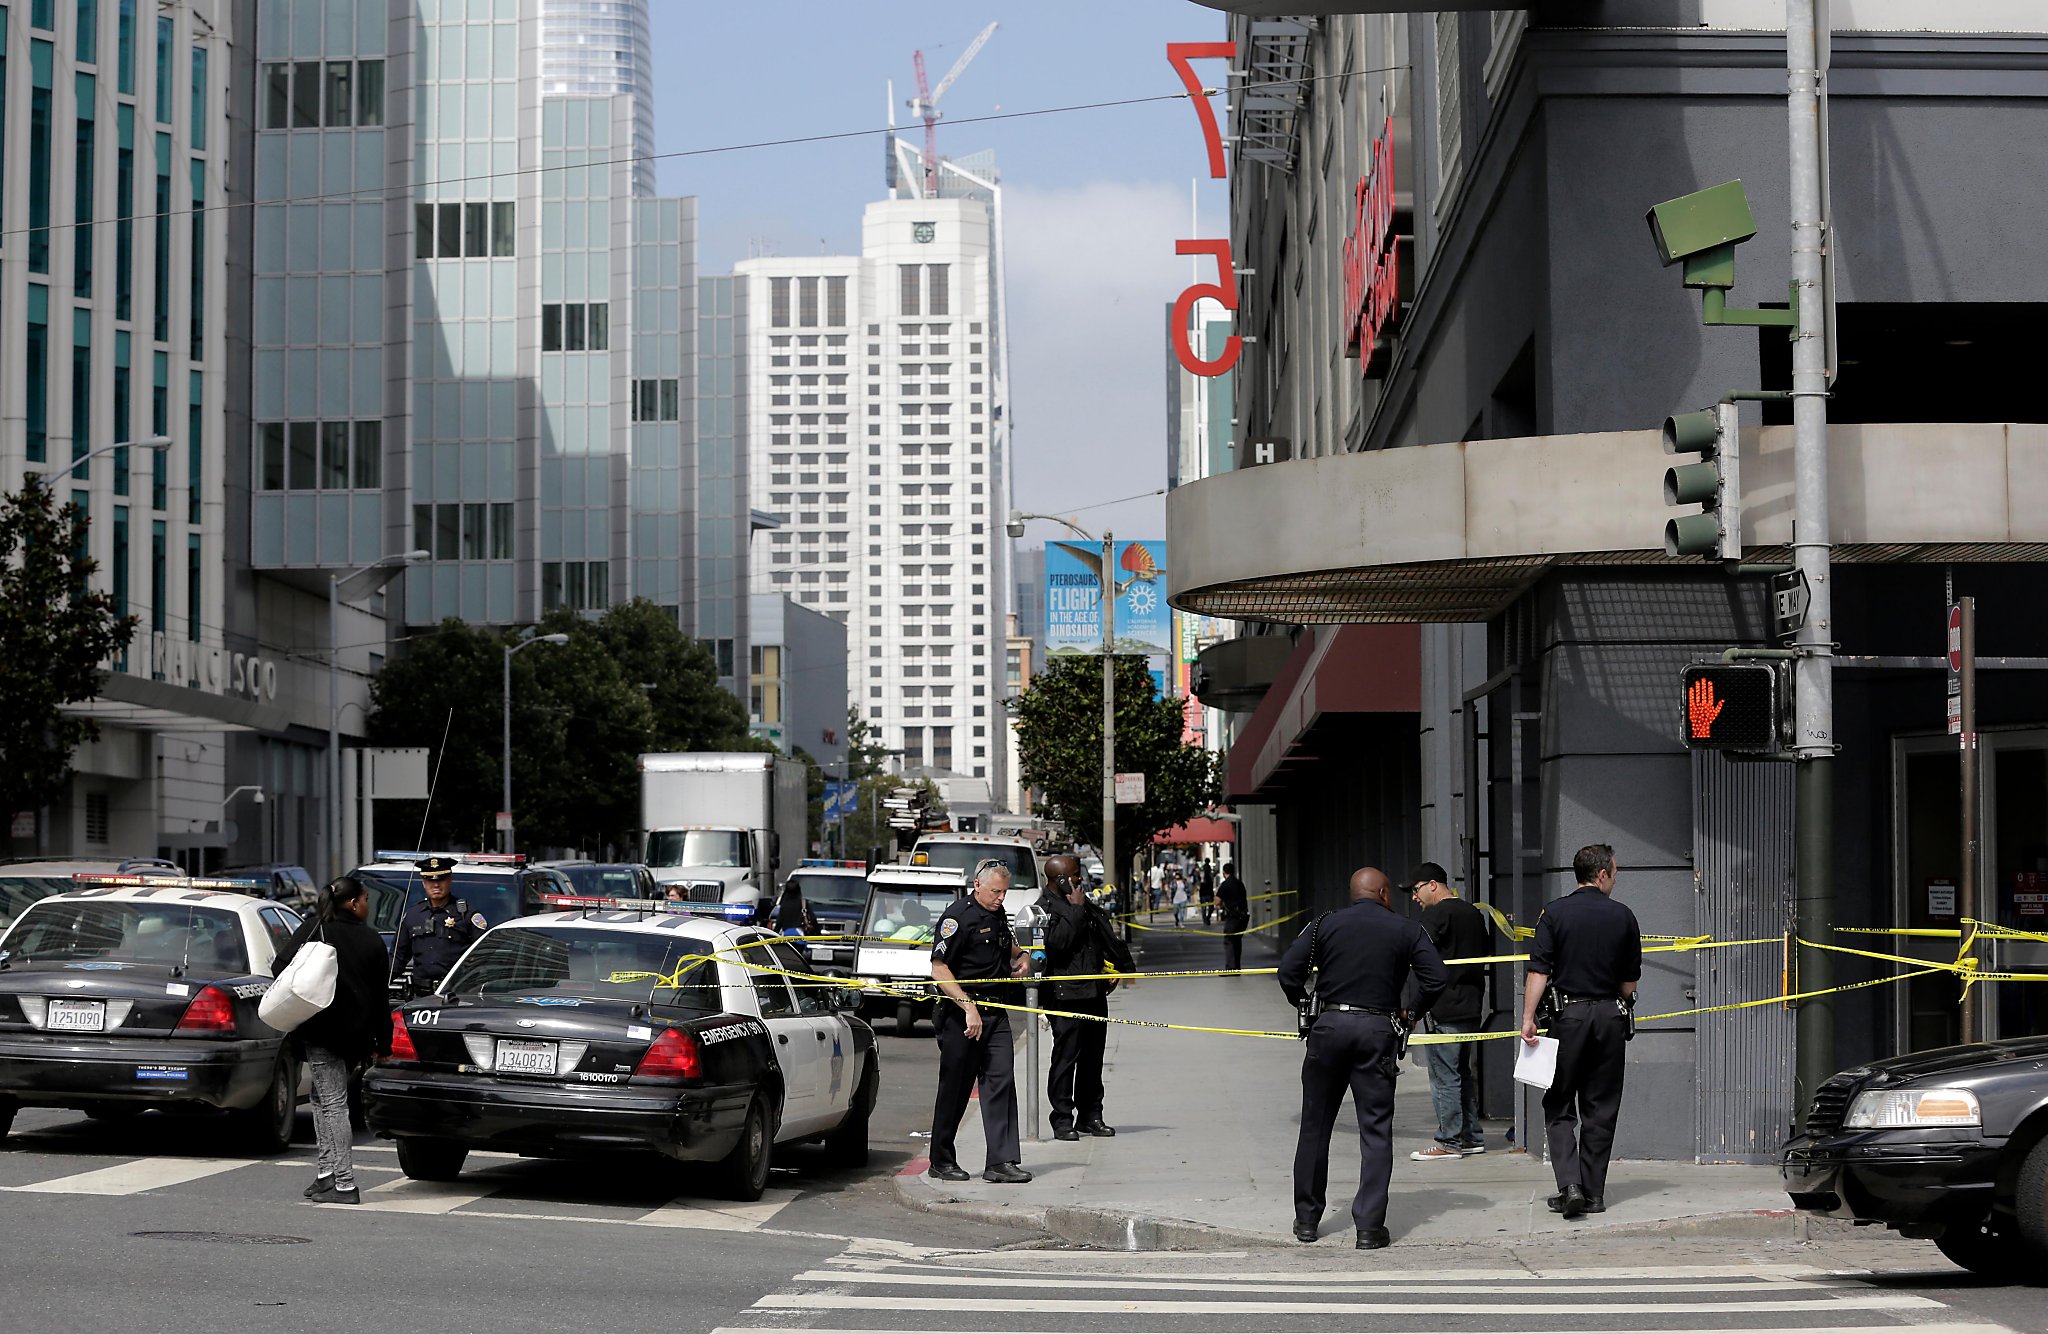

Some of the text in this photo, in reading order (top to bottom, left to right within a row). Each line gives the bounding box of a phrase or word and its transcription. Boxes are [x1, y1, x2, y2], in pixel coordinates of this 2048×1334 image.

[1256, 443, 1274, 463] H
[1050, 574, 1098, 586] PTEROSAURS
[1050, 588, 1098, 610] FLIGHT
[1788, 589, 1800, 614] WAY
[1050, 612, 1098, 623] IN THE AGE OF
[1050, 624, 1098, 637] DINOSAURS
[1183, 612, 1191, 660] OMPUTERS
[233, 983, 274, 999] EMERGEN
[54, 1011, 100, 1025] 1251090
[411, 1010, 441, 1025] 101
[700, 1021, 764, 1046] EMERGENCY 911
[502, 1051, 552, 1068] 1340873
[578, 1072, 618, 1083] 16100170
